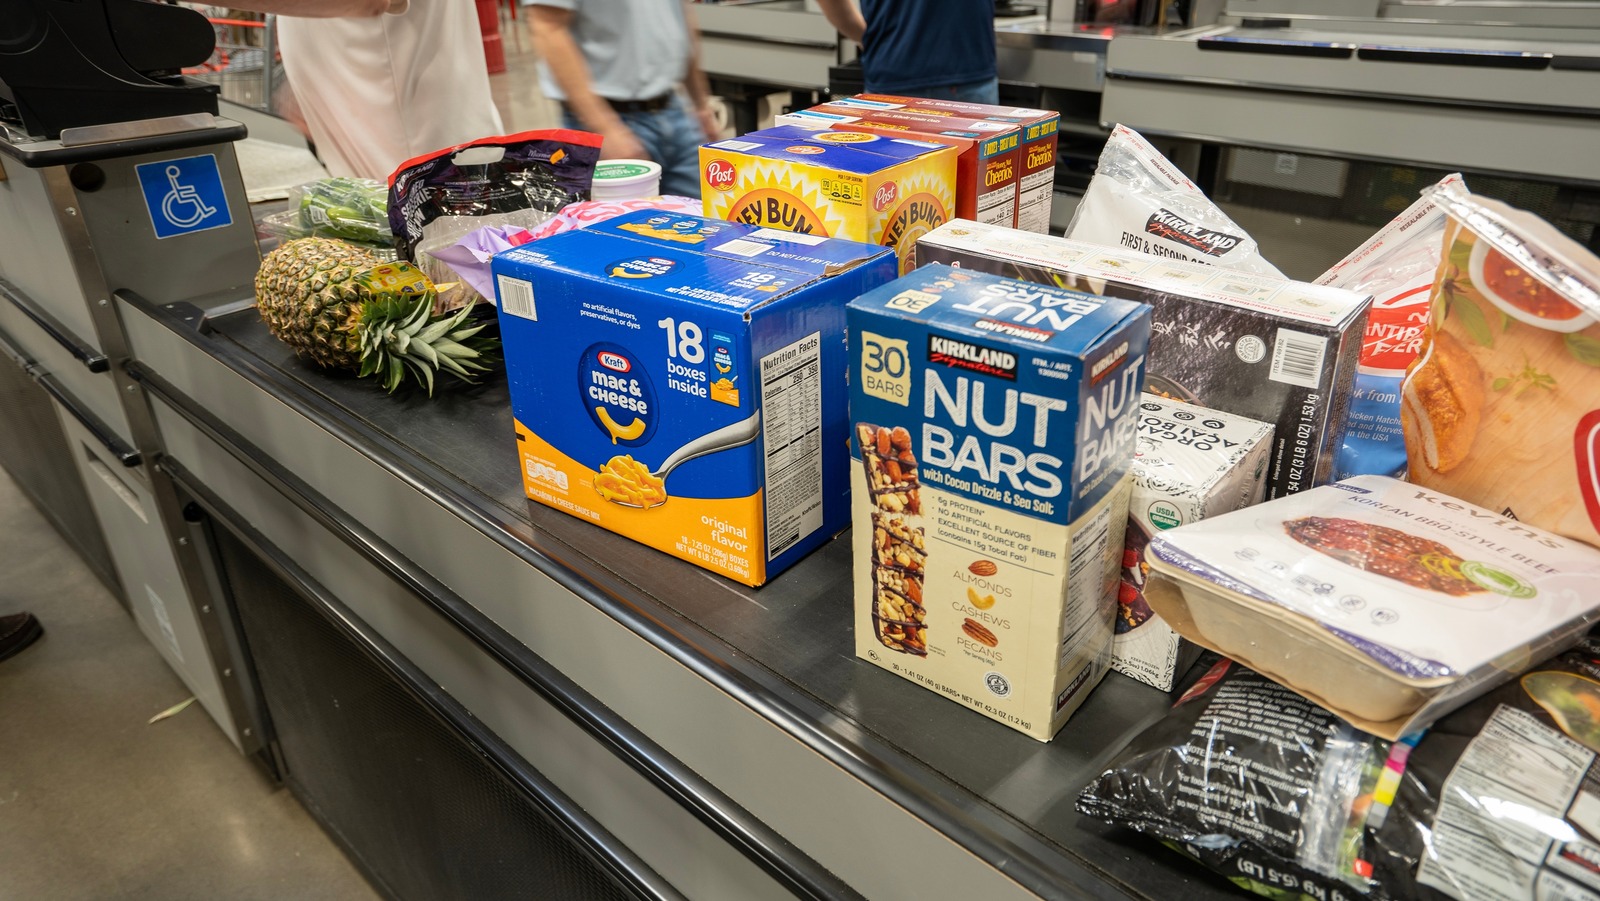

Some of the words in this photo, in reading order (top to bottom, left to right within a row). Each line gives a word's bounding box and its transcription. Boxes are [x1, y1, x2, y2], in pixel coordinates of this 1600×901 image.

[1030, 125, 1039, 139] BOXES
[1041, 122, 1050, 136] GREAT
[987, 141, 997, 155] BOXES
[1000, 135, 1009, 151] GREAT
[1009, 134, 1018, 148] VALUE
[1027, 150, 1052, 169] Cheerios
[708, 162, 733, 184] Post
[985, 166, 1013, 186] Cheerios
[875, 185, 895, 209] Post
[1152, 208, 1237, 250] KIRKLAND
[1399, 209, 1426, 232] RESEALABLE
[1120, 231, 1142, 251] FIRST
[1353, 255, 1363, 264] CUT
[1370, 241, 1383, 252] OPEN
[746, 272, 776, 283] 18
[892, 295, 923, 309] 30
[980, 283, 1102, 316] BARS
[580, 309, 620, 325] preservatives,
[627, 320, 641, 330] dyes
[591, 303, 614, 315] artificial
[615, 308, 637, 322] flavors,
[951, 295, 1083, 331] NUT
[658, 317, 705, 364] 18
[975, 320, 1050, 342] KIRKLAND
[604, 355, 624, 369] Kraft
[763, 348, 796, 371] Nutrition
[799, 339, 818, 353] Facts
[864, 341, 905, 379] 30
[931, 337, 1016, 370] KIRKLAND
[1091, 341, 1129, 378] KIRKLAND
[667, 359, 706, 382] boxes
[793, 372, 803, 383] 250
[808, 364, 818, 375] 350
[930, 353, 1014, 379] Signature
[1032, 358, 1049, 368] ITM.
[1054, 362, 1072, 372] ART.
[592, 370, 627, 391] mac
[629, 380, 642, 397] &
[668, 376, 707, 398] inside
[765, 385, 782, 398] Calories
[867, 376, 904, 398] BARS
[1084, 354, 1144, 442] NUT
[1304, 393, 1320, 405] kg
[1367, 389, 1395, 404] from
[924, 368, 1068, 448] NUT
[1300, 405, 1315, 423] 1.53
[1296, 423, 1313, 439] OZ)
[1357, 430, 1369, 439] the
[1372, 433, 1389, 442] USA
[1358, 422, 1373, 431] and
[1079, 401, 1139, 483] BARS
[1293, 446, 1306, 458] LB
[922, 422, 1063, 498] BARS
[1291, 459, 1306, 468] (3
[1272, 464, 1281, 481] Enlarged
[1289, 468, 1302, 481] OZ
[923, 468, 943, 483] with
[944, 473, 971, 492] Cocoa
[972, 479, 1001, 501] Drizzle
[1003, 490, 1012, 504] &
[1013, 493, 1031, 508] Sea
[1033, 498, 1054, 515] Salt
[1287, 480, 1300, 492] 54
[529, 486, 552, 502] MACARONI
[557, 498, 575, 510] CHEESE
[575, 504, 590, 517] SAUCE
[591, 511, 600, 520] MIX
[938, 497, 947, 507] 6g
[1156, 506, 1175, 518] USDA
[701, 515, 747, 539] original
[938, 507, 950, 516] NO
[951, 510, 992, 531] ARTIFICIAL
[995, 525, 1032, 542] FLAVORS
[1072, 520, 1096, 544] Nutrition
[1097, 507, 1110, 526] Facts
[1152, 514, 1178, 527] ORGANIC
[711, 530, 748, 552] flavor
[938, 518, 980, 537] EXCELLENT
[982, 532, 1015, 548] SOURCE
[1018, 543, 1029, 552] OF
[1031, 547, 1057, 559] FIBER
[938, 527, 971, 545] (contains
[974, 540, 986, 551] 15g
[988, 544, 1007, 557] Total
[1010, 551, 1027, 563] Fat)
[1348, 495, 1414, 518] KOREAN
[1414, 516, 1510, 554] BBQ-STYLE
[1510, 553, 1561, 575] BEEF
[675, 542, 686, 552] NET
[688, 546, 697, 556] WT
[702, 552, 710, 561] LB
[710, 556, 718, 565] 2.5
[719, 559, 727, 569] OZ
[681, 535, 688, 544] 18
[692, 539, 702, 550] 7.25
[704, 544, 711, 553] OZ
[729, 553, 749, 568] BOXES
[953, 570, 1013, 598] ALMONDS
[952, 601, 1011, 630] CASHEWS
[956, 636, 1003, 662] PECANS
[971, 652, 985, 663] Serving
[1140, 665, 1159, 679] 1.06kg
[1142, 659, 1160, 671] FROZEN
[1059, 663, 1091, 704] KIRKLAND
[892, 663, 900, 671] 30
[904, 668, 915, 678] 1.41
[916, 673, 924, 682] OZ
[925, 676, 934, 687] (40
[934, 681, 941, 691] g)
[961, 694, 973, 704] NET
[974, 700, 984, 709] WT
[984, 704, 998, 715] 42.3
[998, 710, 1007, 719] OZ
[1008, 714, 1019, 725] (1.2
[1020, 719, 1031, 731] kg)
[1228, 704, 1248, 712] Cover
[1263, 710, 1304, 724] microwave
[1304, 721, 1315, 729] on
[1264, 718, 1278, 726] and
[1279, 721, 1297, 730] cook
[1251, 762, 1294, 782] microwave
[1186, 802, 1200, 811] NOT
[1234, 816, 1273, 834] CONTENTS
[1274, 830, 1295, 843] ONCE
[1236, 857, 1264, 879] LB)
[1267, 868, 1299, 888] (5.5
[1302, 880, 1326, 901] kg
